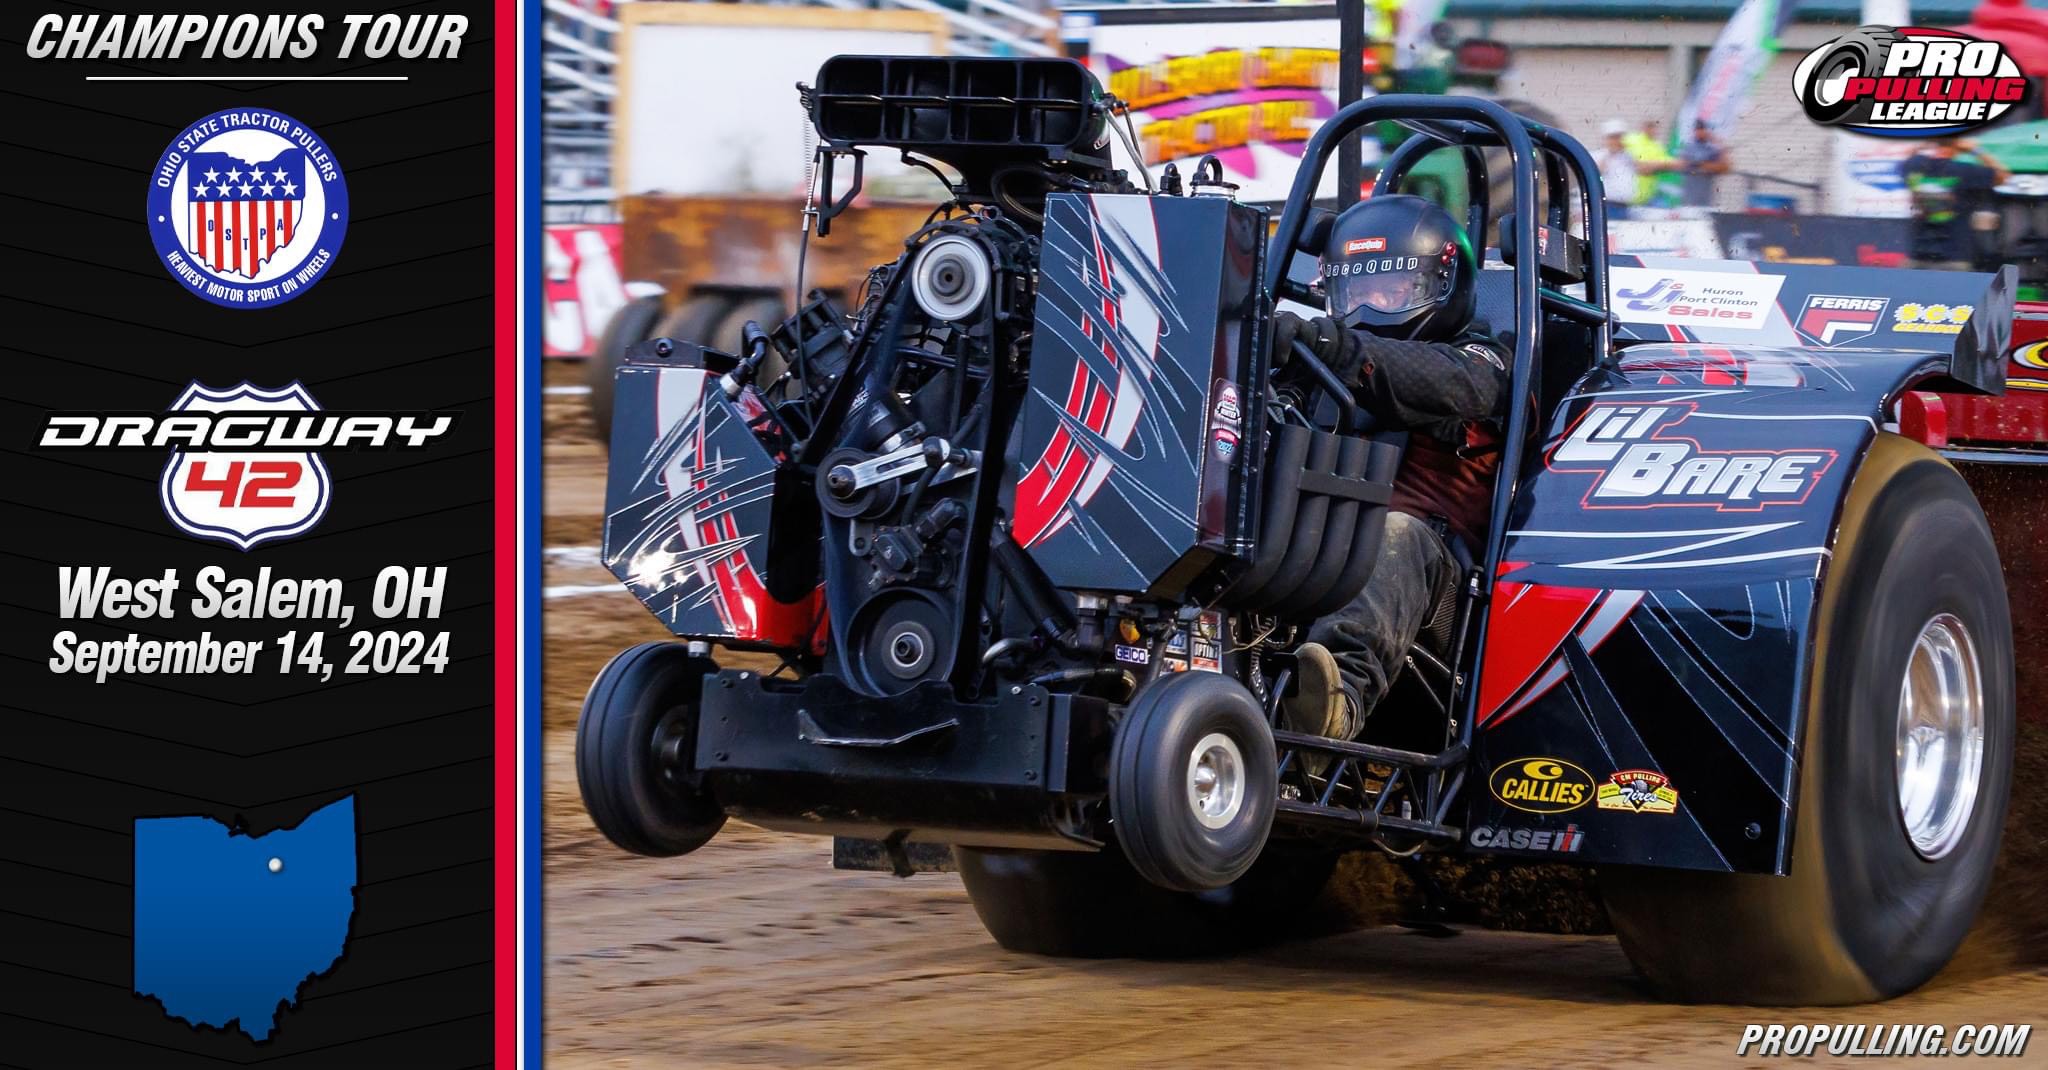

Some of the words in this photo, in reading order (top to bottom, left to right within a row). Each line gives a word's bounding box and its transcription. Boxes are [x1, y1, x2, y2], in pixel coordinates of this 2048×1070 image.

[1702, 287, 1744, 296] Huron
[1679, 295, 1706, 304] Port
[1710, 297, 1758, 306] Clinton
[1810, 297, 1882, 311] FERRIS
[1667, 305, 1753, 319] Sales
[1554, 407, 1667, 461] Lil
[1502, 777, 1585, 804] CALLIES
[1620, 787, 1658, 804] Tires
[1470, 828, 1552, 850] CASE
